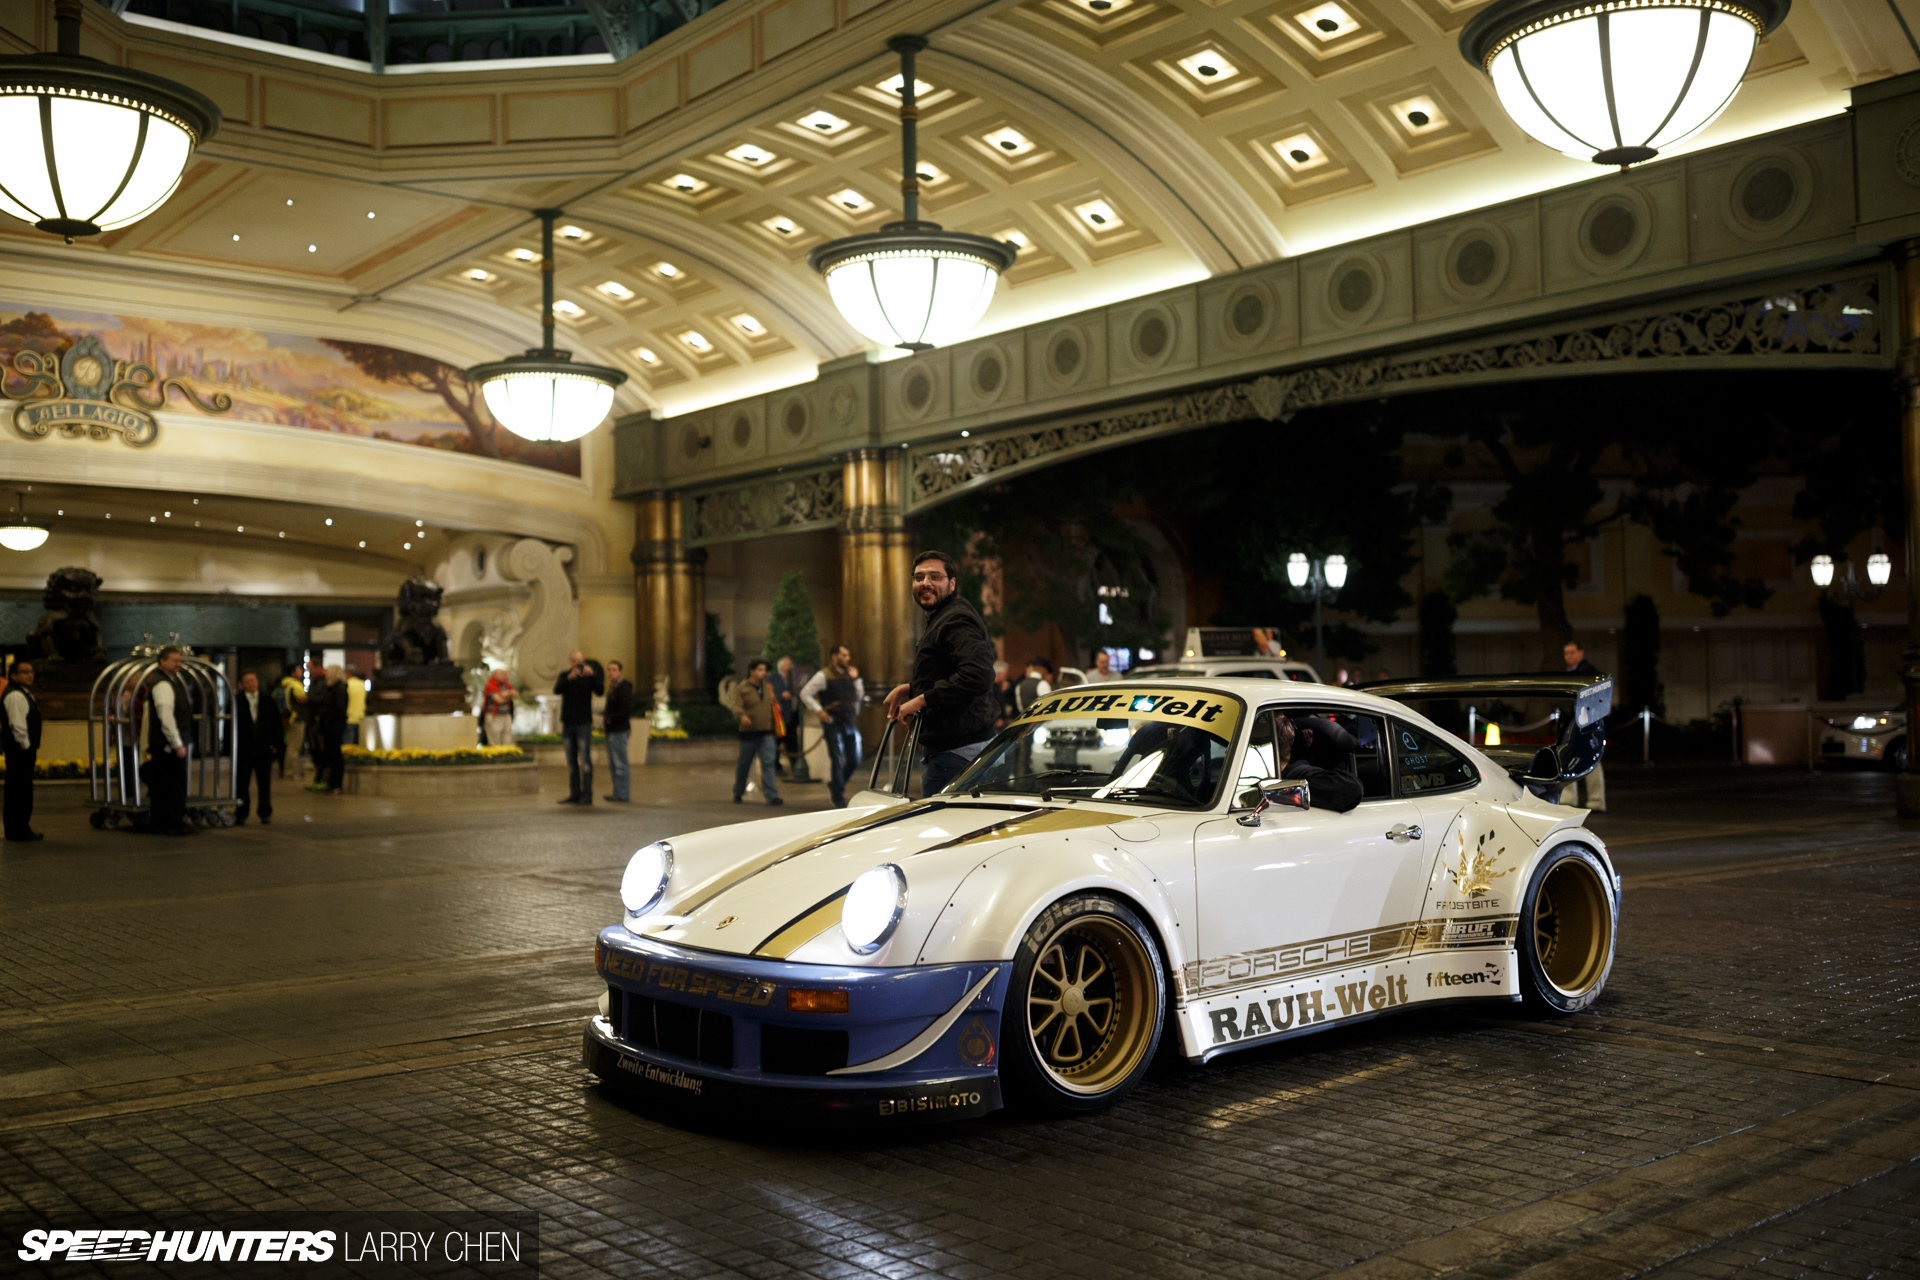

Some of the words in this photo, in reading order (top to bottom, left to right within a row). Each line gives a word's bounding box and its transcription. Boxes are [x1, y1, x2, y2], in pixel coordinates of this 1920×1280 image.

[36, 403, 140, 428] BELLAGIO
[1404, 755, 1429, 766] GHOST
[1400, 773, 1446, 789] RWB
[1436, 899, 1500, 910] FROSTBITE
[1467, 922, 1496, 934] LIFT
[1200, 935, 1371, 986] PORSCHE
[603, 951, 645, 982] NEED
[646, 963, 689, 992] FOR
[688, 973, 777, 1007] SPEED
[1208, 974, 1409, 1044] RAUH-Welt
[617, 1054, 644, 1077] Zweite
[645, 1063, 703, 1096] Entwicklung
[897, 1091, 981, 1113] BISIMOTO
